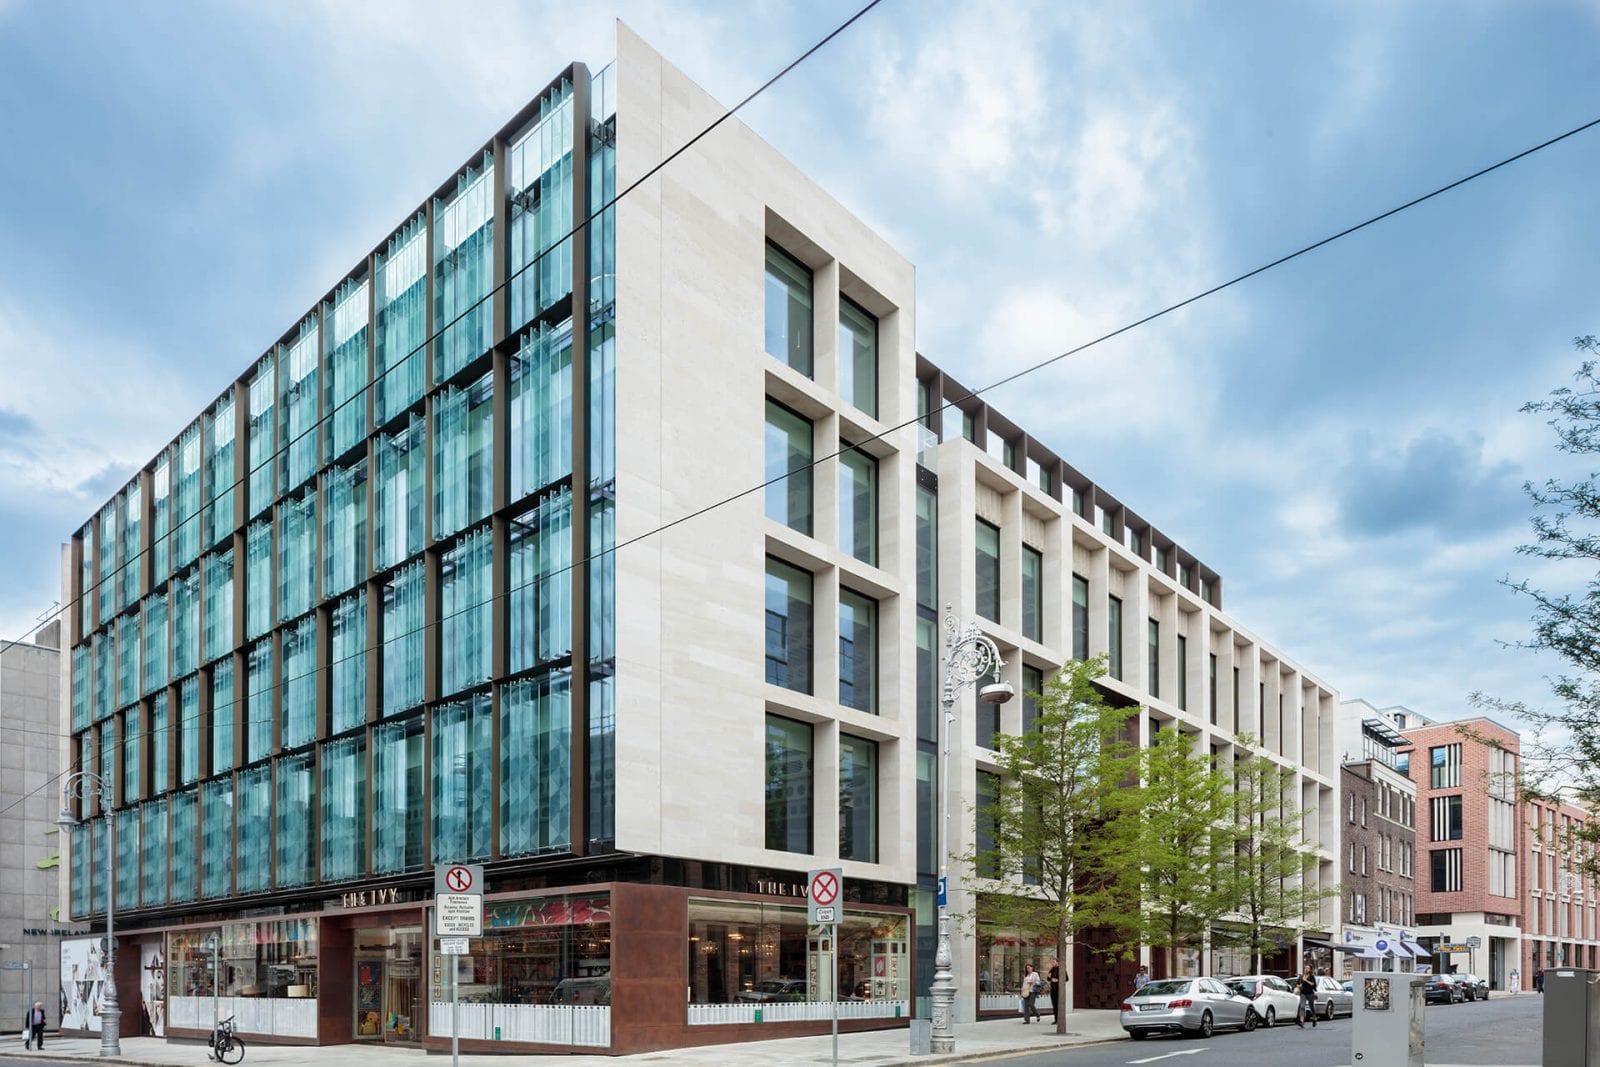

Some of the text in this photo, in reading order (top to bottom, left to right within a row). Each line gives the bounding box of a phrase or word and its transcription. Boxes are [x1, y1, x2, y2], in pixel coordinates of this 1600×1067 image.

[757, 880, 809, 897] THE IV
[340, 887, 397, 908] THE IVY
[23, 928, 48, 936] NEW
